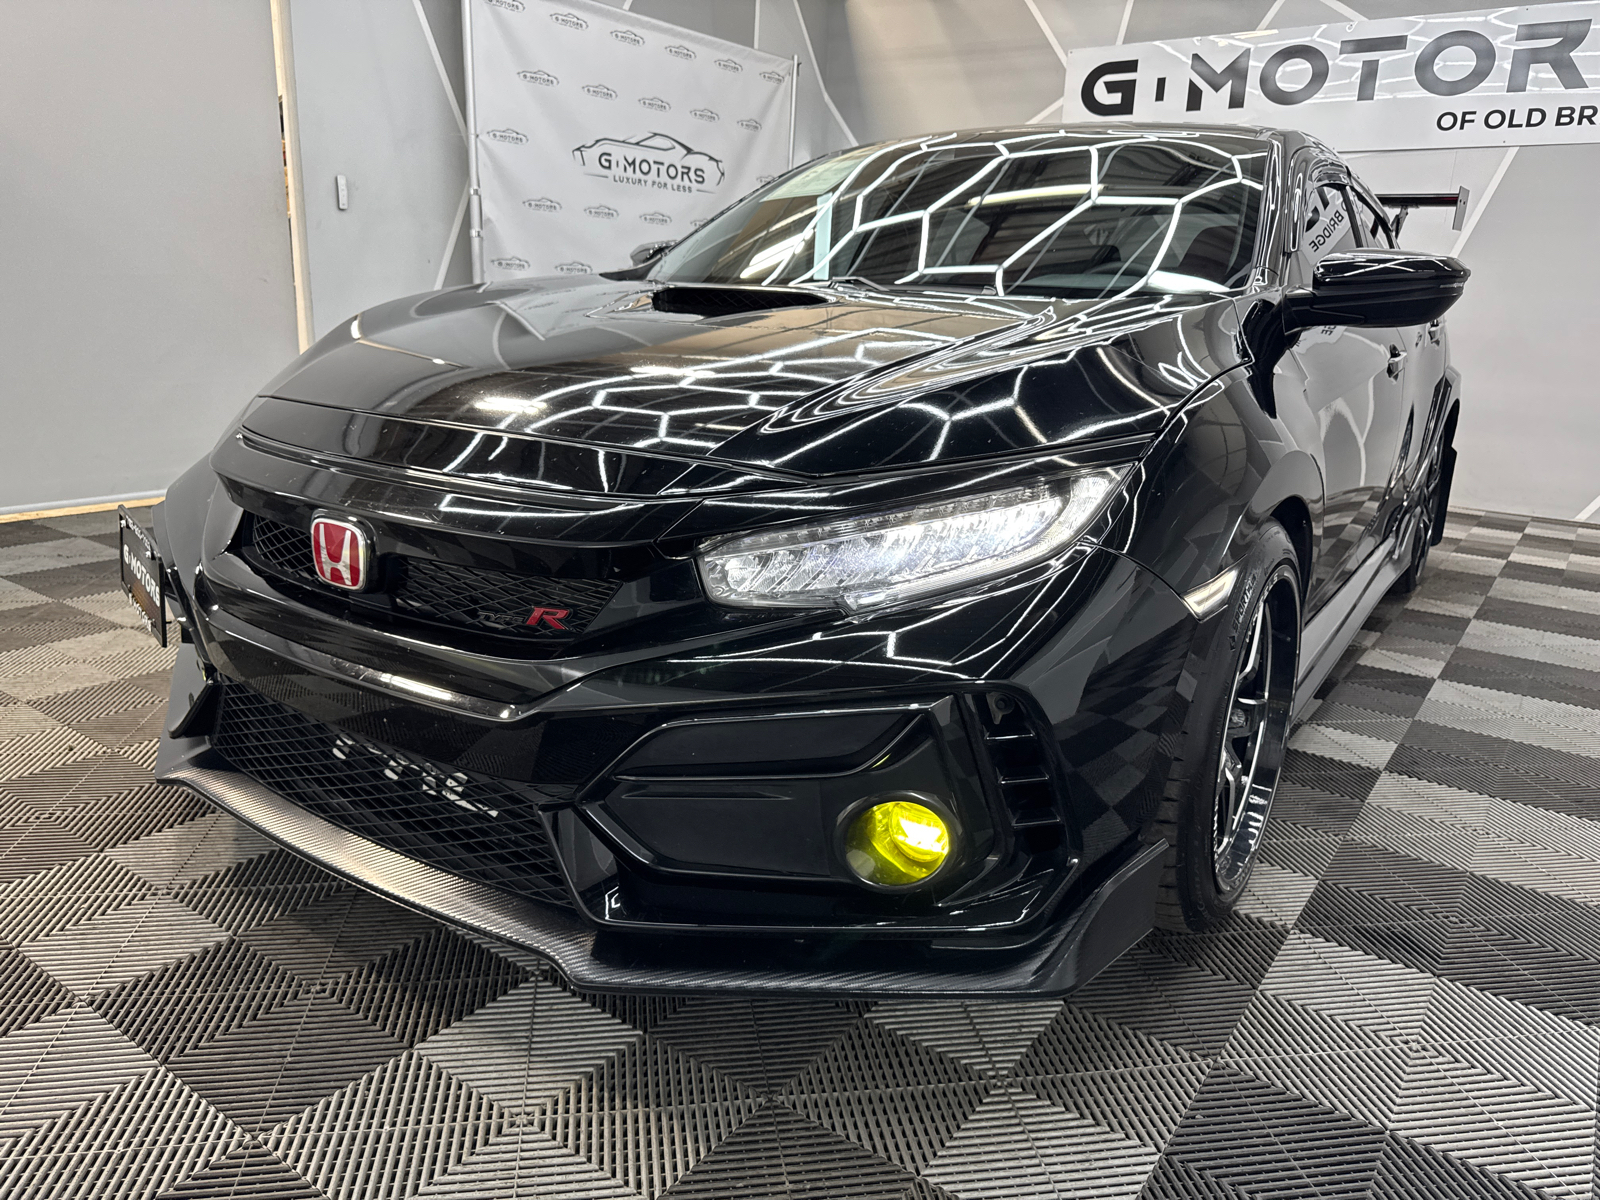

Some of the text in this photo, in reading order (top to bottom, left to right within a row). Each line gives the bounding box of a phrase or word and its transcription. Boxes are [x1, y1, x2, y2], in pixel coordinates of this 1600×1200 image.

[1436, 105, 1598, 131] OF OLD BR
[613, 175, 693, 193] LUXURY FOR LESS
[526, 606, 569, 630] R
